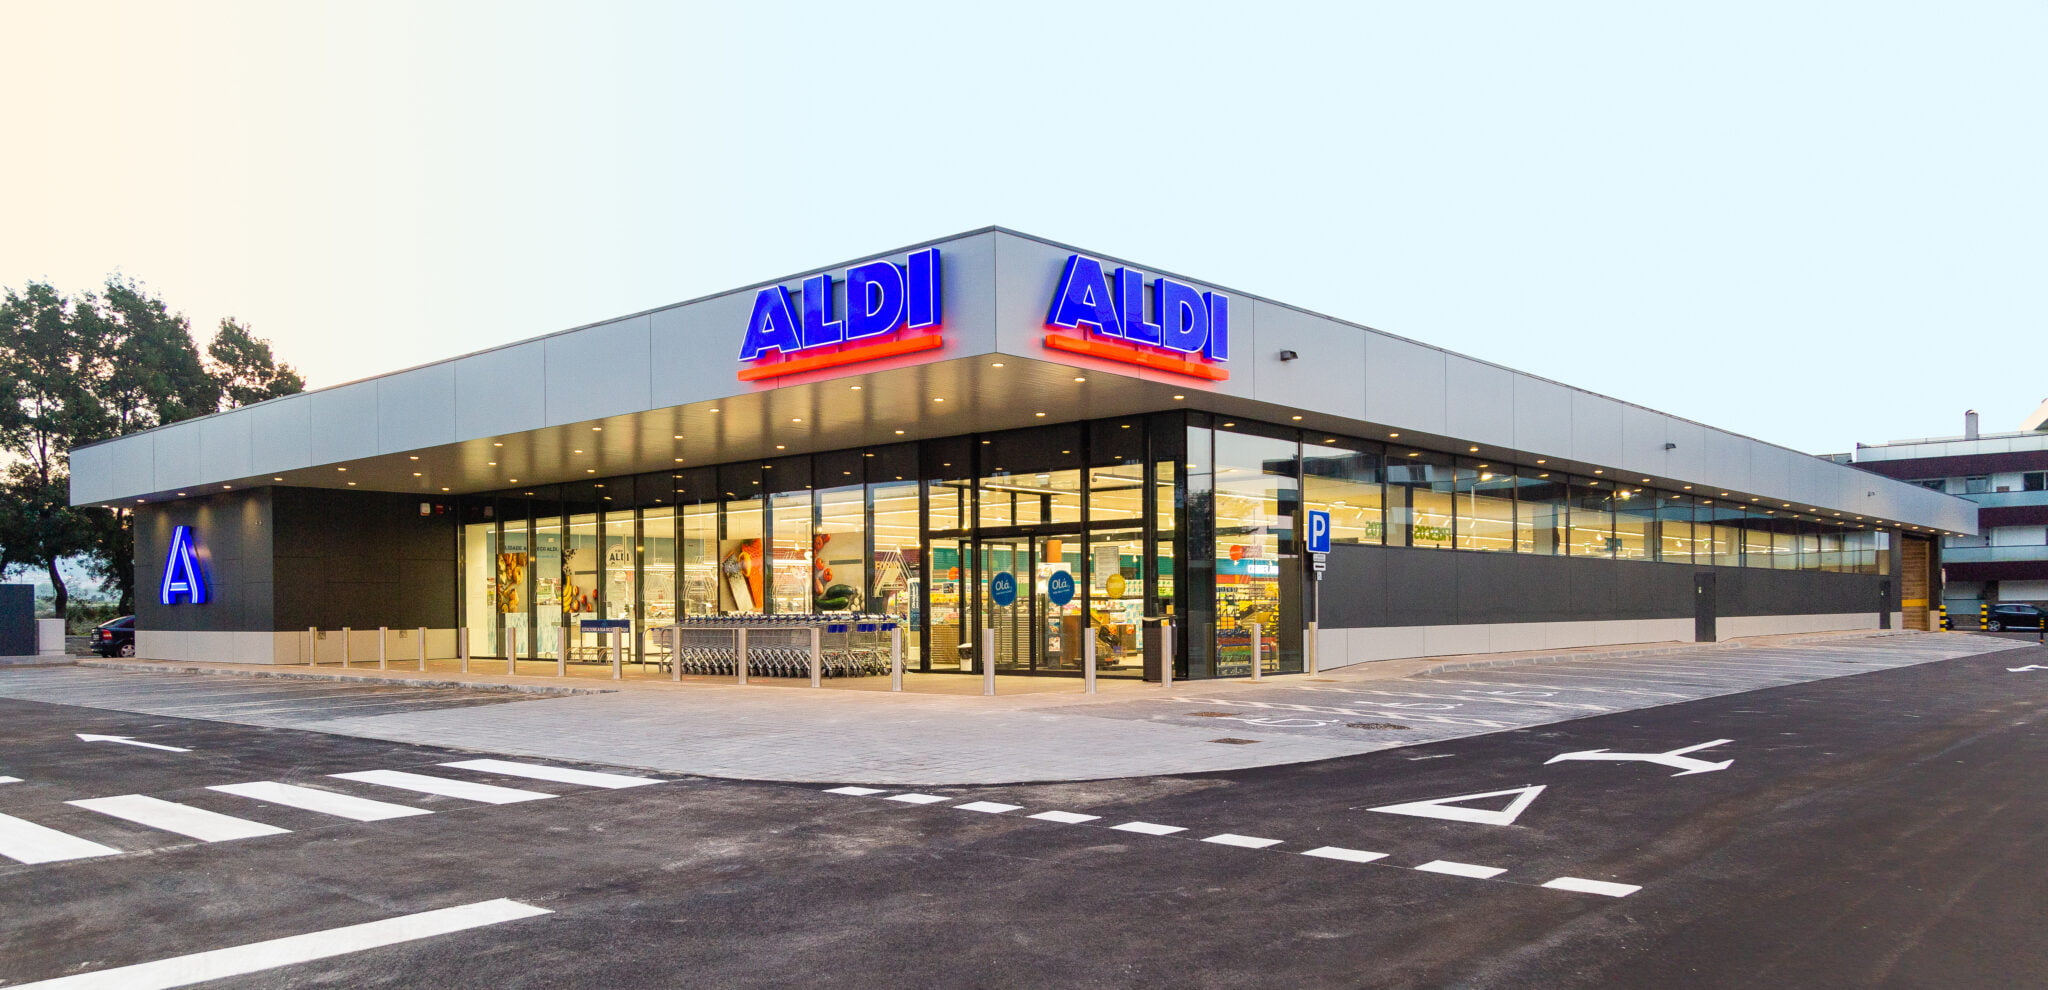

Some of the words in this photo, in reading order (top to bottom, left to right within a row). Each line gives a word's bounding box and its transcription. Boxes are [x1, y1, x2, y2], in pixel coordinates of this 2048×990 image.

[738, 247, 941, 362] ALDI
[1047, 254, 1230, 361] ALDI
[1313, 514, 1326, 548] P
[160, 525, 207, 605] A
[995, 579, 1010, 591] Olá
[1052, 577, 1067, 590] Olá
